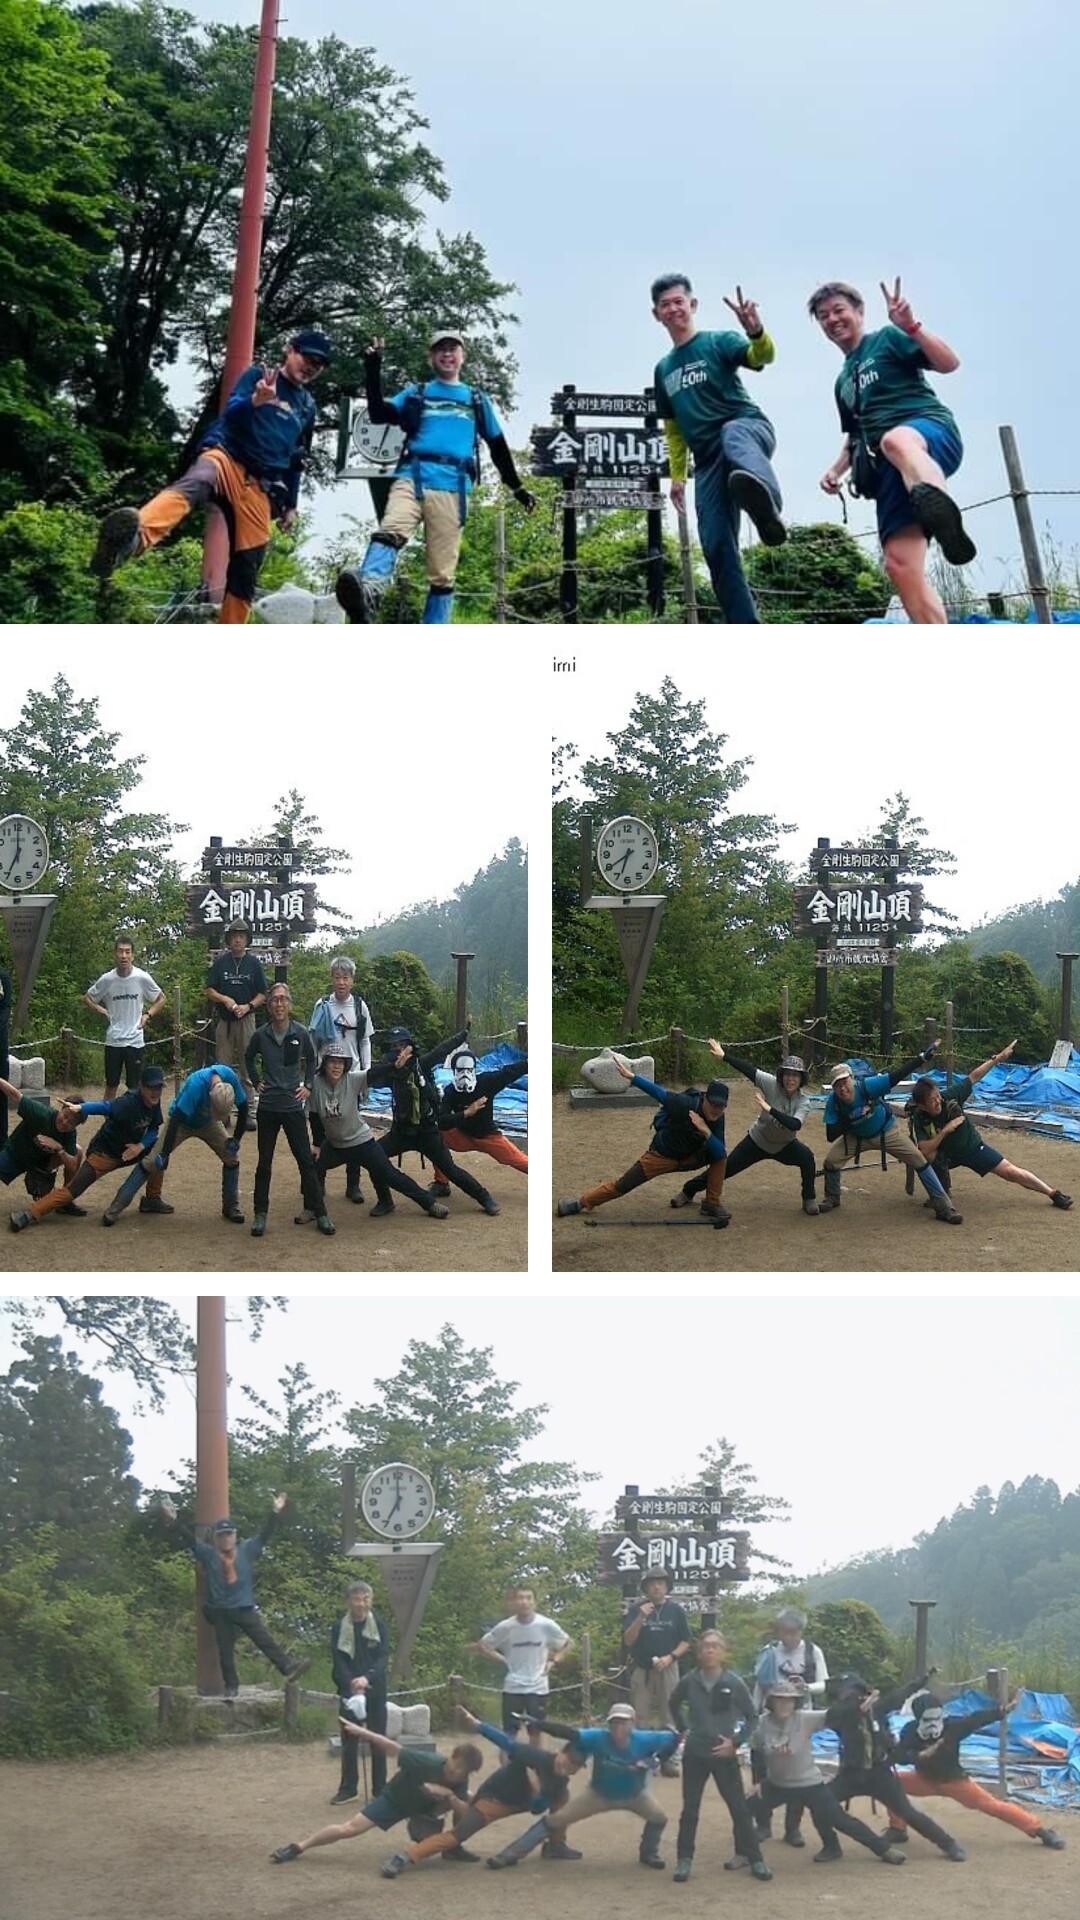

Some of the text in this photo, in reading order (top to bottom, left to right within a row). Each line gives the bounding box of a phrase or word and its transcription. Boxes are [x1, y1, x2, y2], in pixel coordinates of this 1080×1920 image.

[624, 825, 632, 834] 12
[605, 840, 615, 848] 10
[642, 837, 650, 846] 2
[214, 852, 293, 867] 金剛生駒国定公園
[645, 850, 652, 858] 3
[822, 853, 900, 868] 金剛生駒国定公園
[200, 889, 305, 923] 金剛山頂
[807, 889, 912, 924] 金剛山頂
[371, 1487, 382, 1495] 10
[419, 1497, 427, 1506] 3
[630, 1501, 722, 1515] 金剛生駒国定公園
[612, 1537, 738, 1572] 金剛山頂
